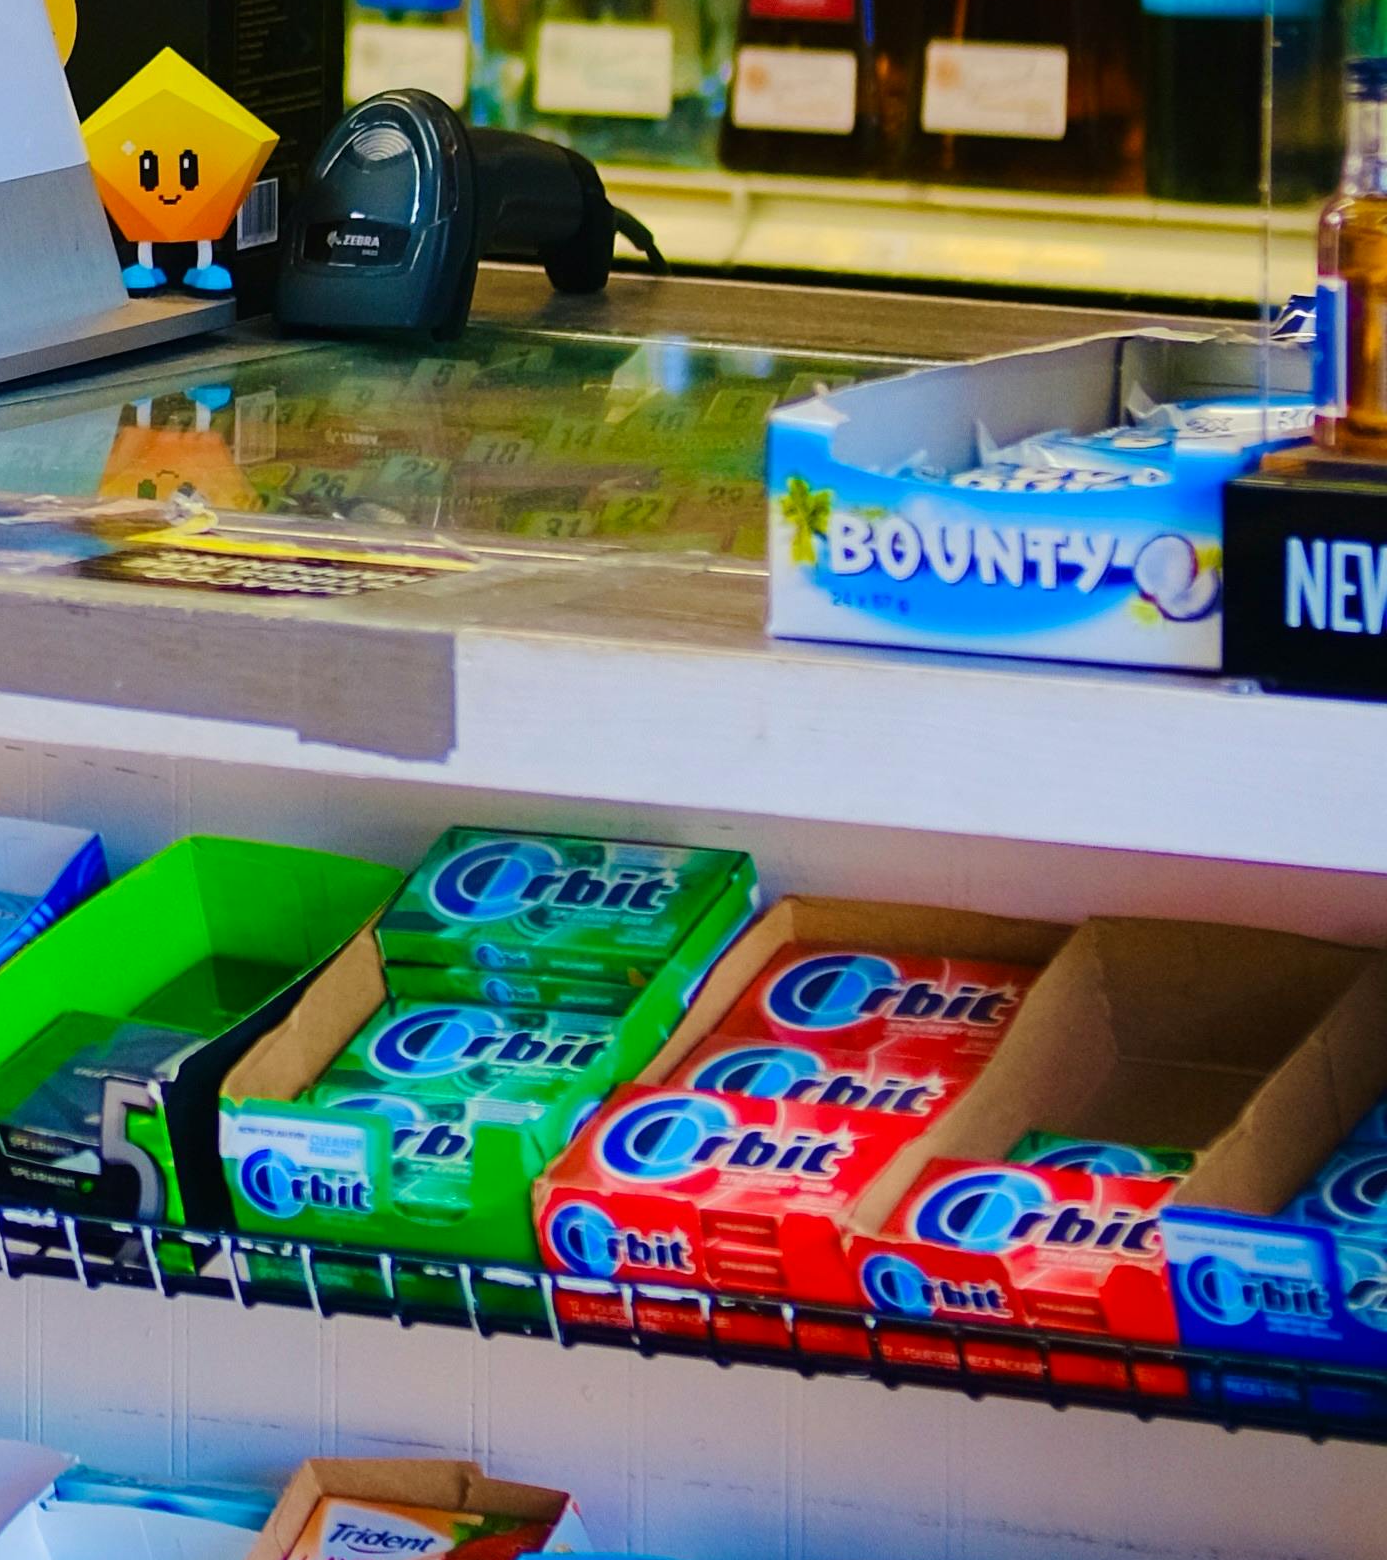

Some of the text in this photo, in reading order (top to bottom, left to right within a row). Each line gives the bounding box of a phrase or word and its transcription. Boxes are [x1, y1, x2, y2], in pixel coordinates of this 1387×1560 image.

[340, 232, 381, 249] ZEBRA
[829, 514, 1118, 594] BOUNTY
[766, 950, 1020, 1032] Orbit
[597, 1091, 855, 1186] Orbit
[549, 1199, 696, 1277] Orbit
[860, 1252, 1011, 1320] Orbit
